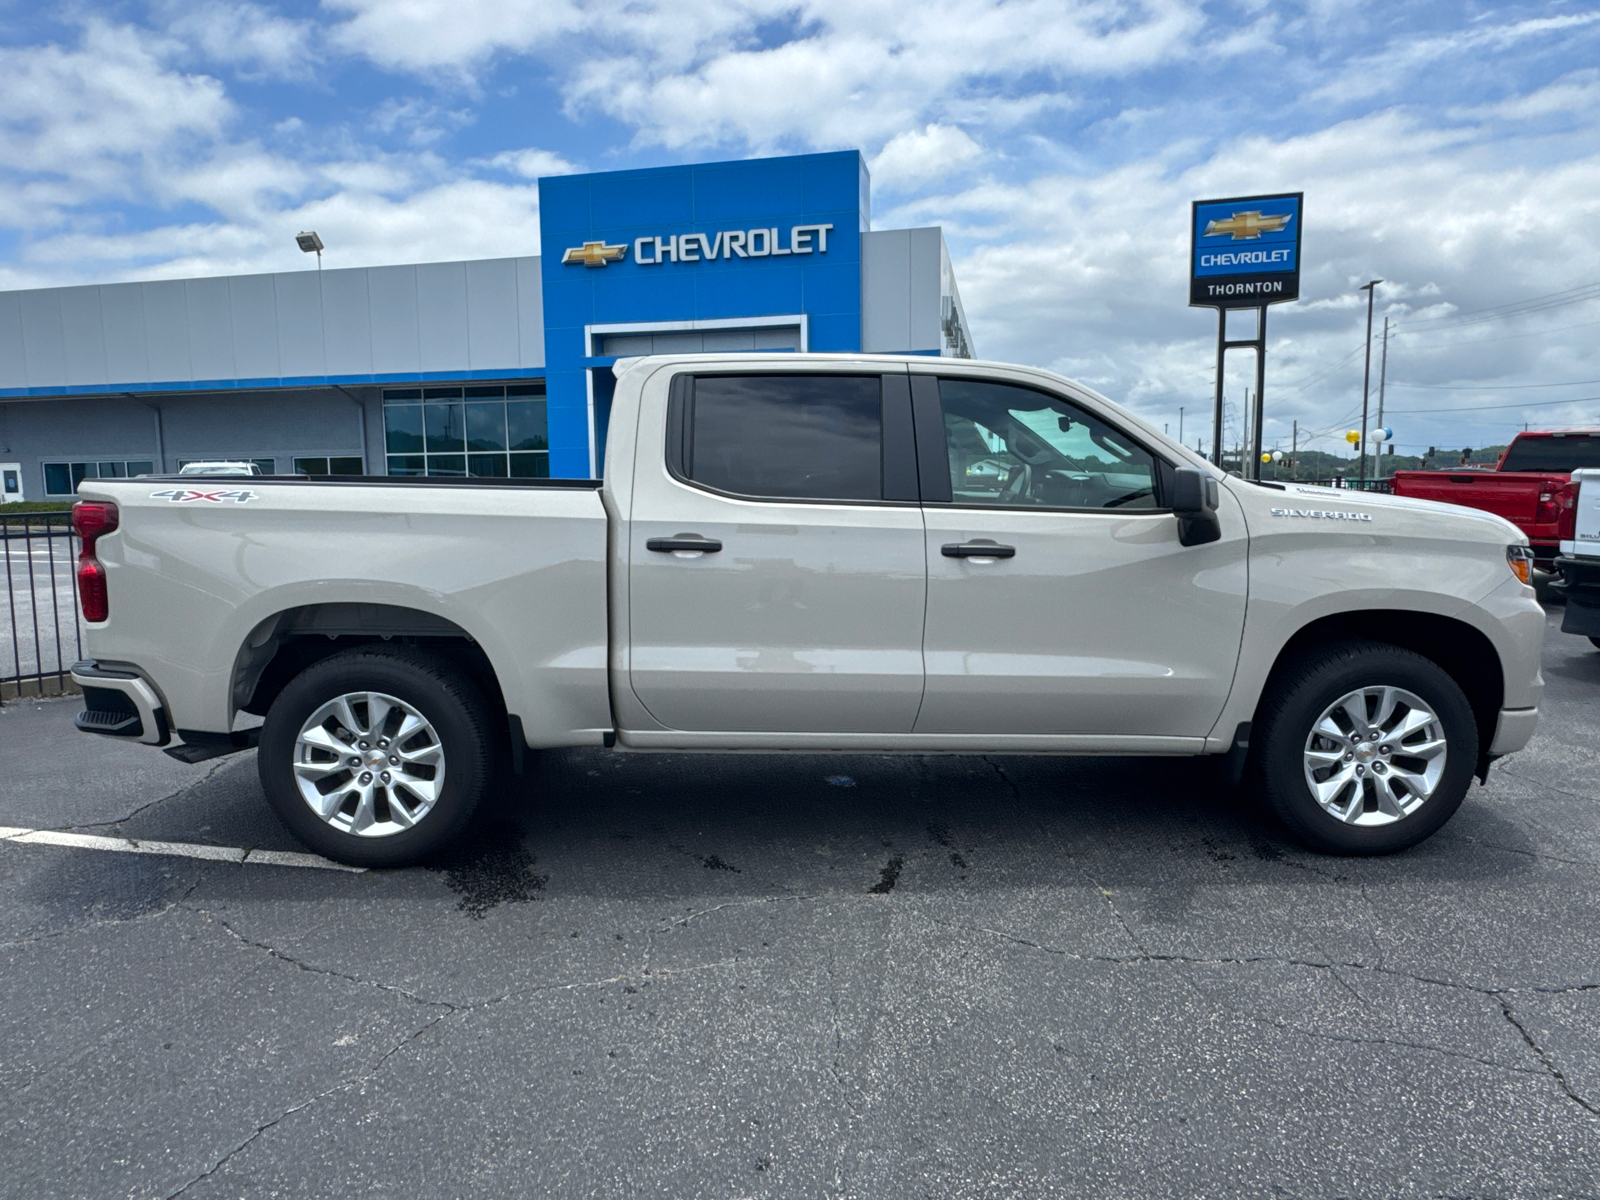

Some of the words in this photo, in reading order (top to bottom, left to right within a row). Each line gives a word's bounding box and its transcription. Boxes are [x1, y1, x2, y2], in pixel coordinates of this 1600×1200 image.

[634, 223, 833, 265] CHEVROLET
[1201, 249, 1290, 267] CHEVROLET
[1208, 281, 1282, 296] THORNTON
[1271, 507, 1372, 521] SILVERADO
